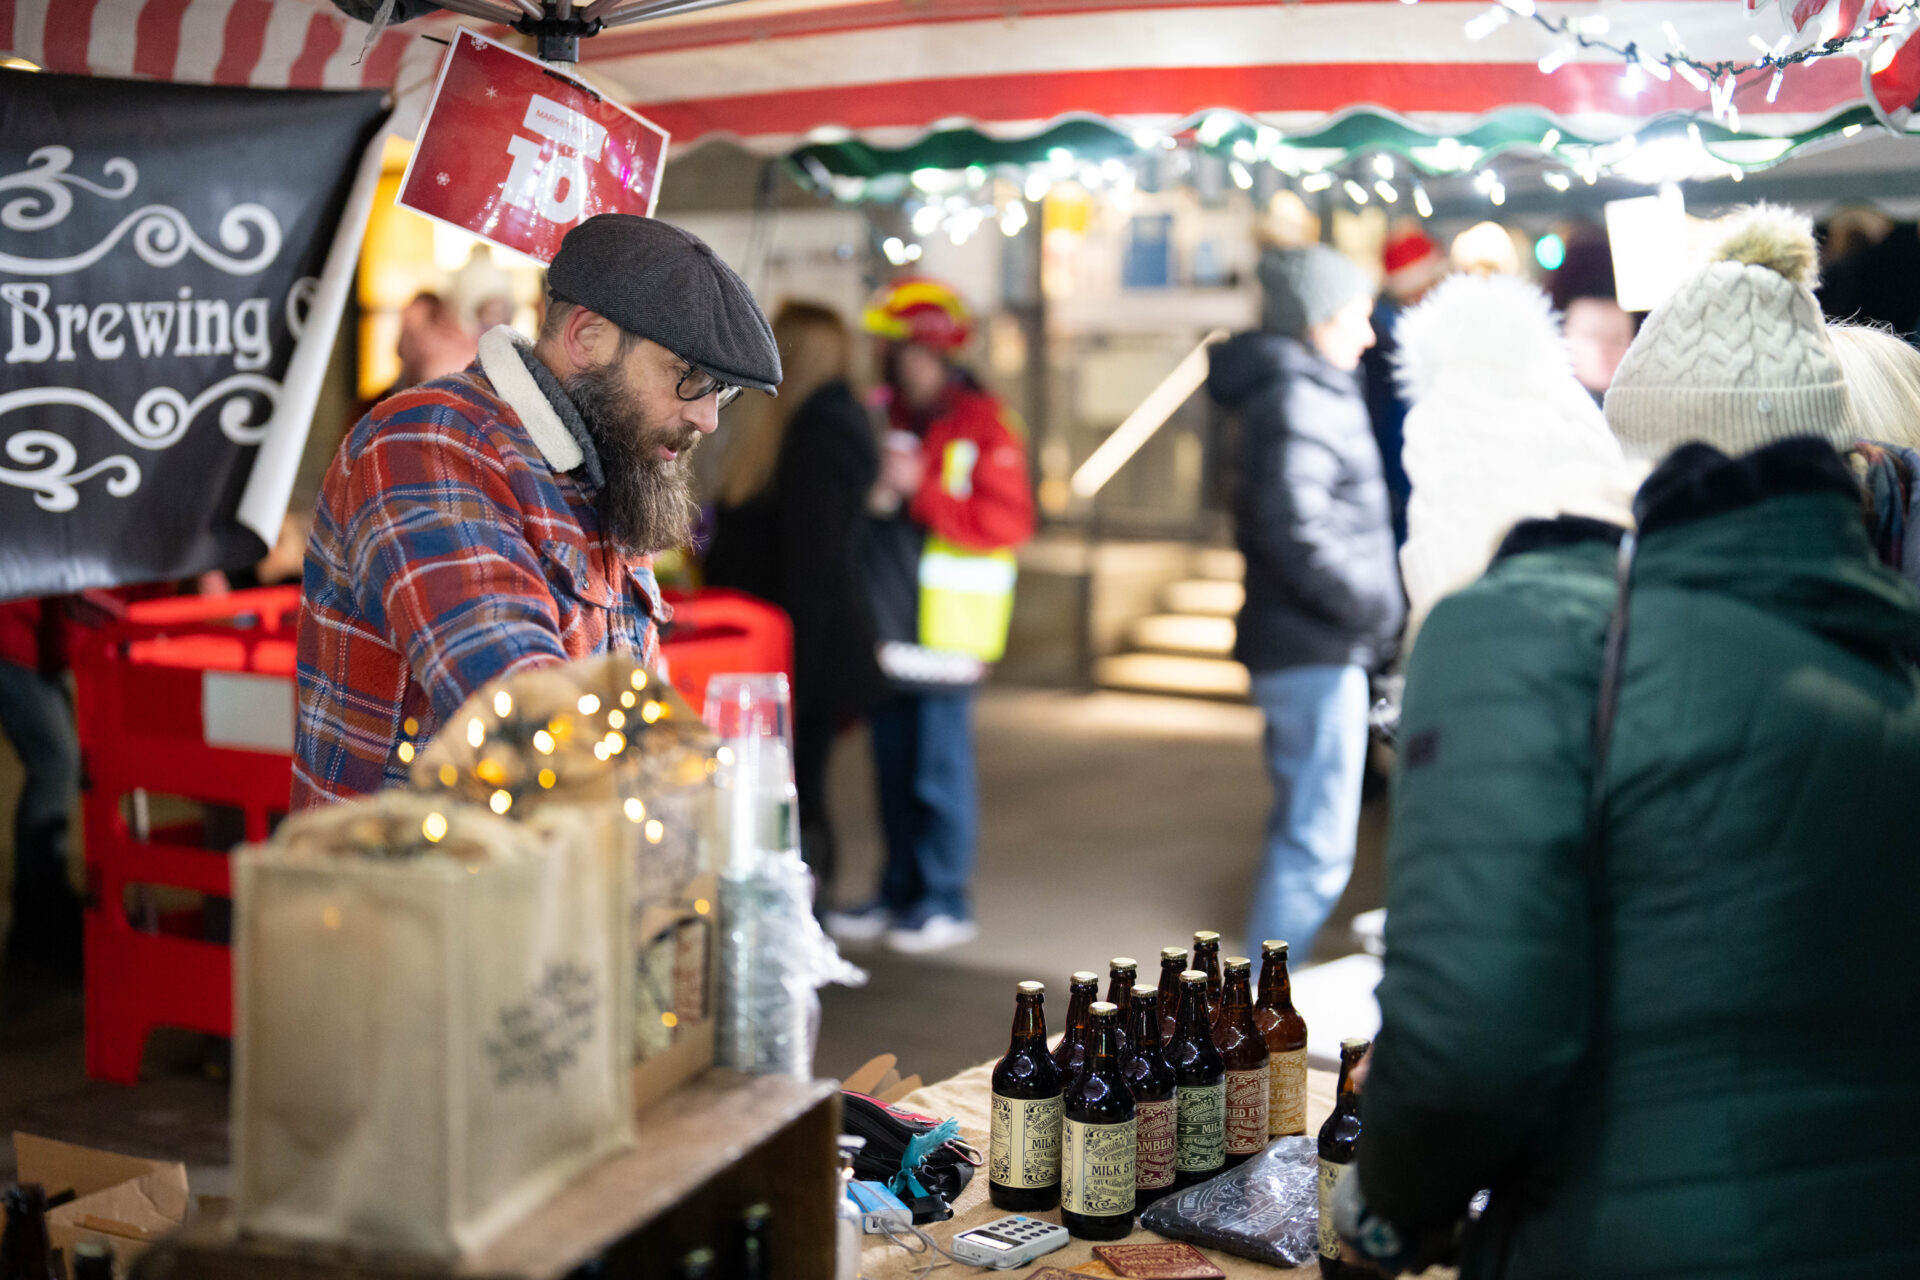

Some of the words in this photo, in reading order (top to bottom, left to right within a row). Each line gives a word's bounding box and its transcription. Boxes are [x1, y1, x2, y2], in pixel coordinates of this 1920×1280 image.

[534, 108, 571, 131] MARKET
[500, 133, 588, 224] 10
[0, 282, 271, 371] Brewing
[1226, 1108, 1246, 1118] RED
[1202, 1120, 1224, 1134] MILD
[1032, 1136, 1057, 1150] MILK
[1136, 1138, 1173, 1152] AMBER
[1091, 1164, 1121, 1176] MILK
